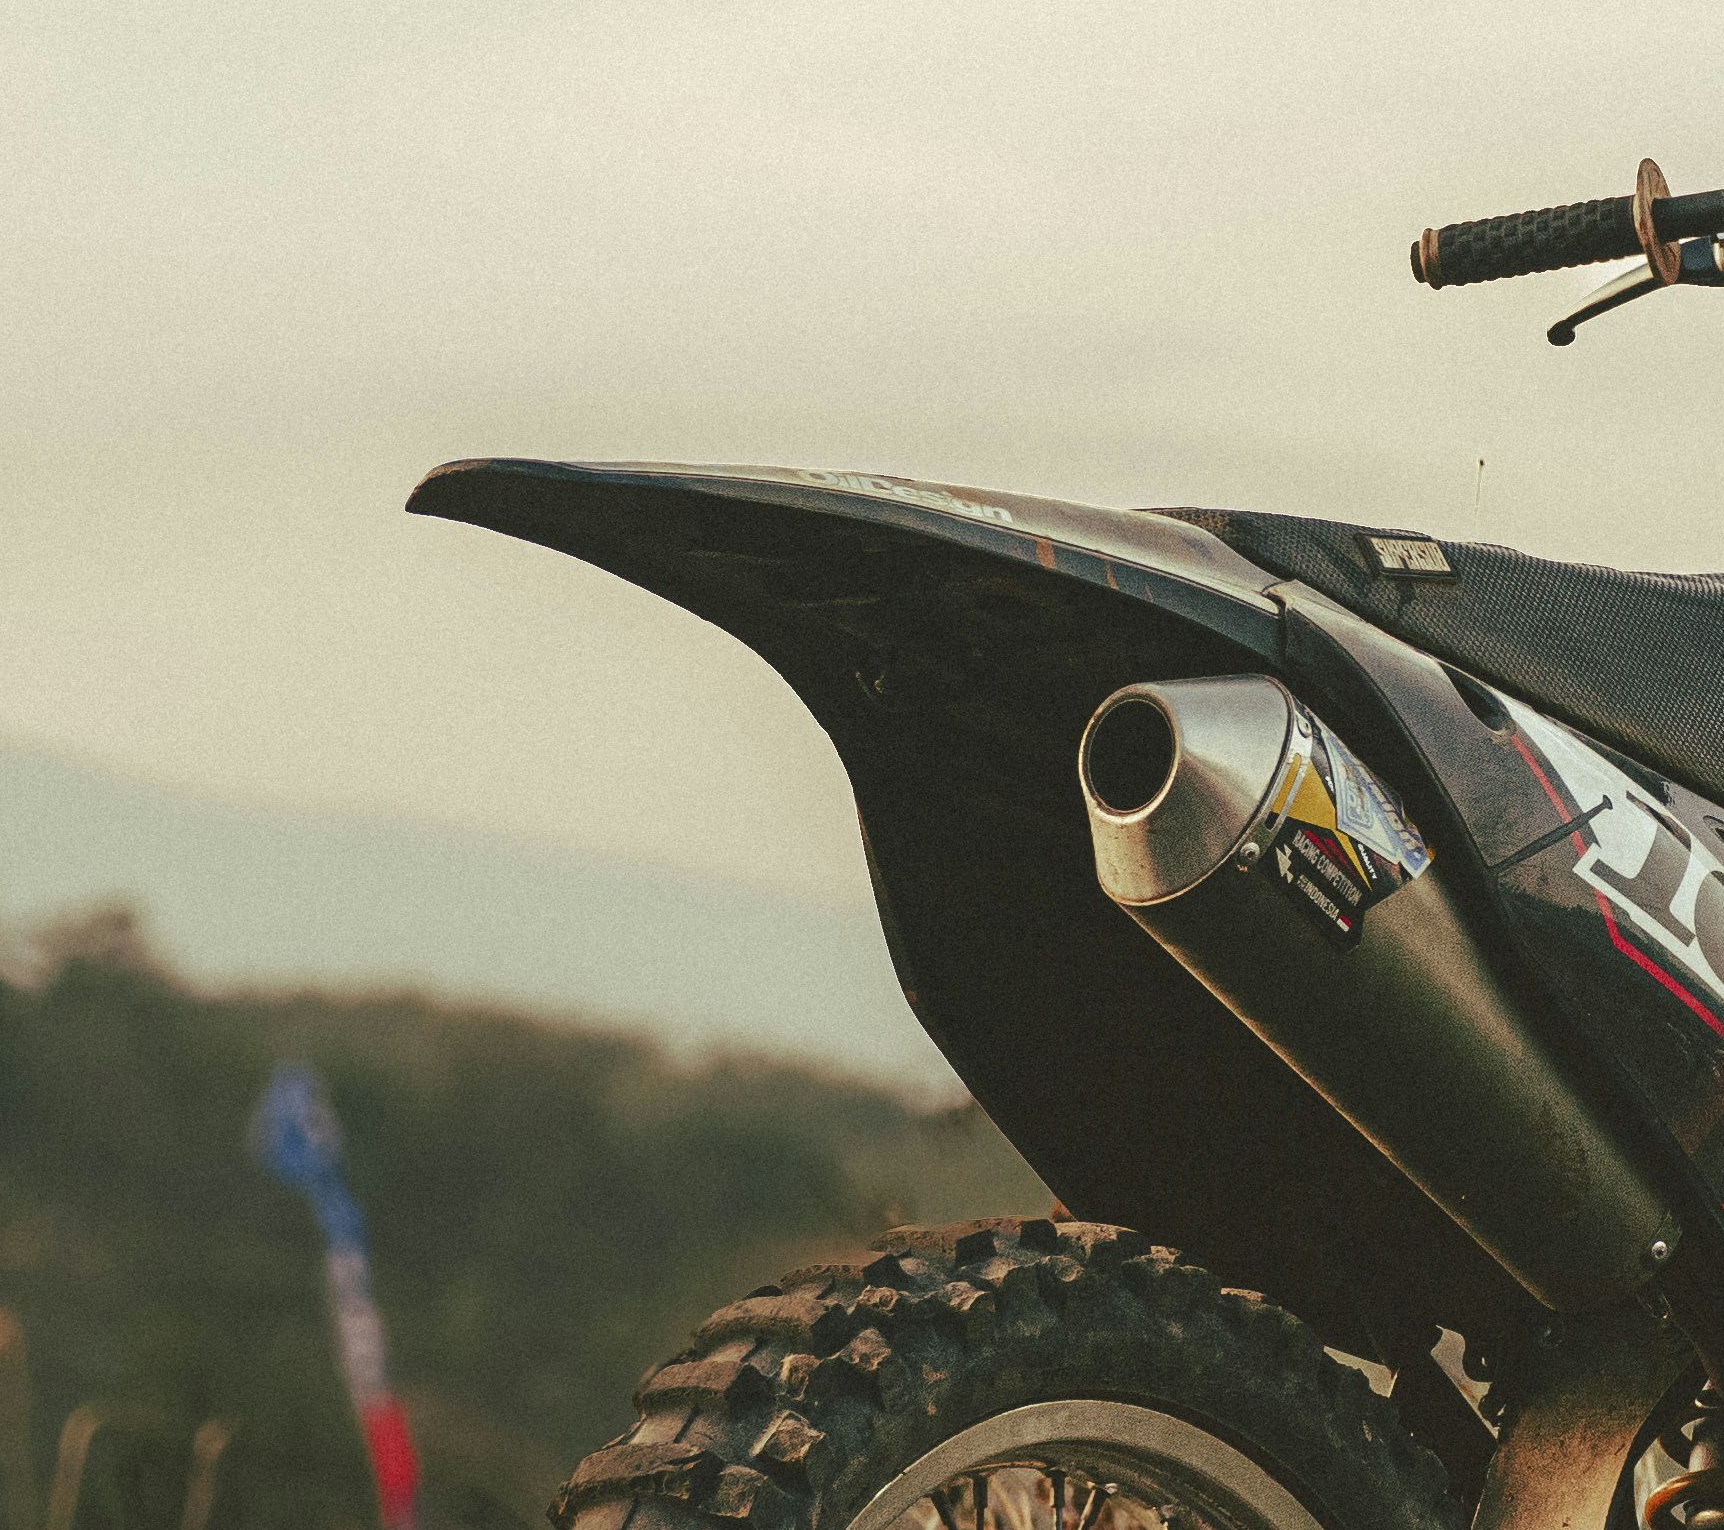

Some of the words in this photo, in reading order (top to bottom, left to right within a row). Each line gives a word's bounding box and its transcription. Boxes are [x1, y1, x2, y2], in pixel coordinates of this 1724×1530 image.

[1291, 829, 1321, 865] RACING
[1316, 854, 1363, 907] COMPETITION
[1357, 843, 1378, 880] QUALITY
[1302, 877, 1341, 922] INDONESIA
